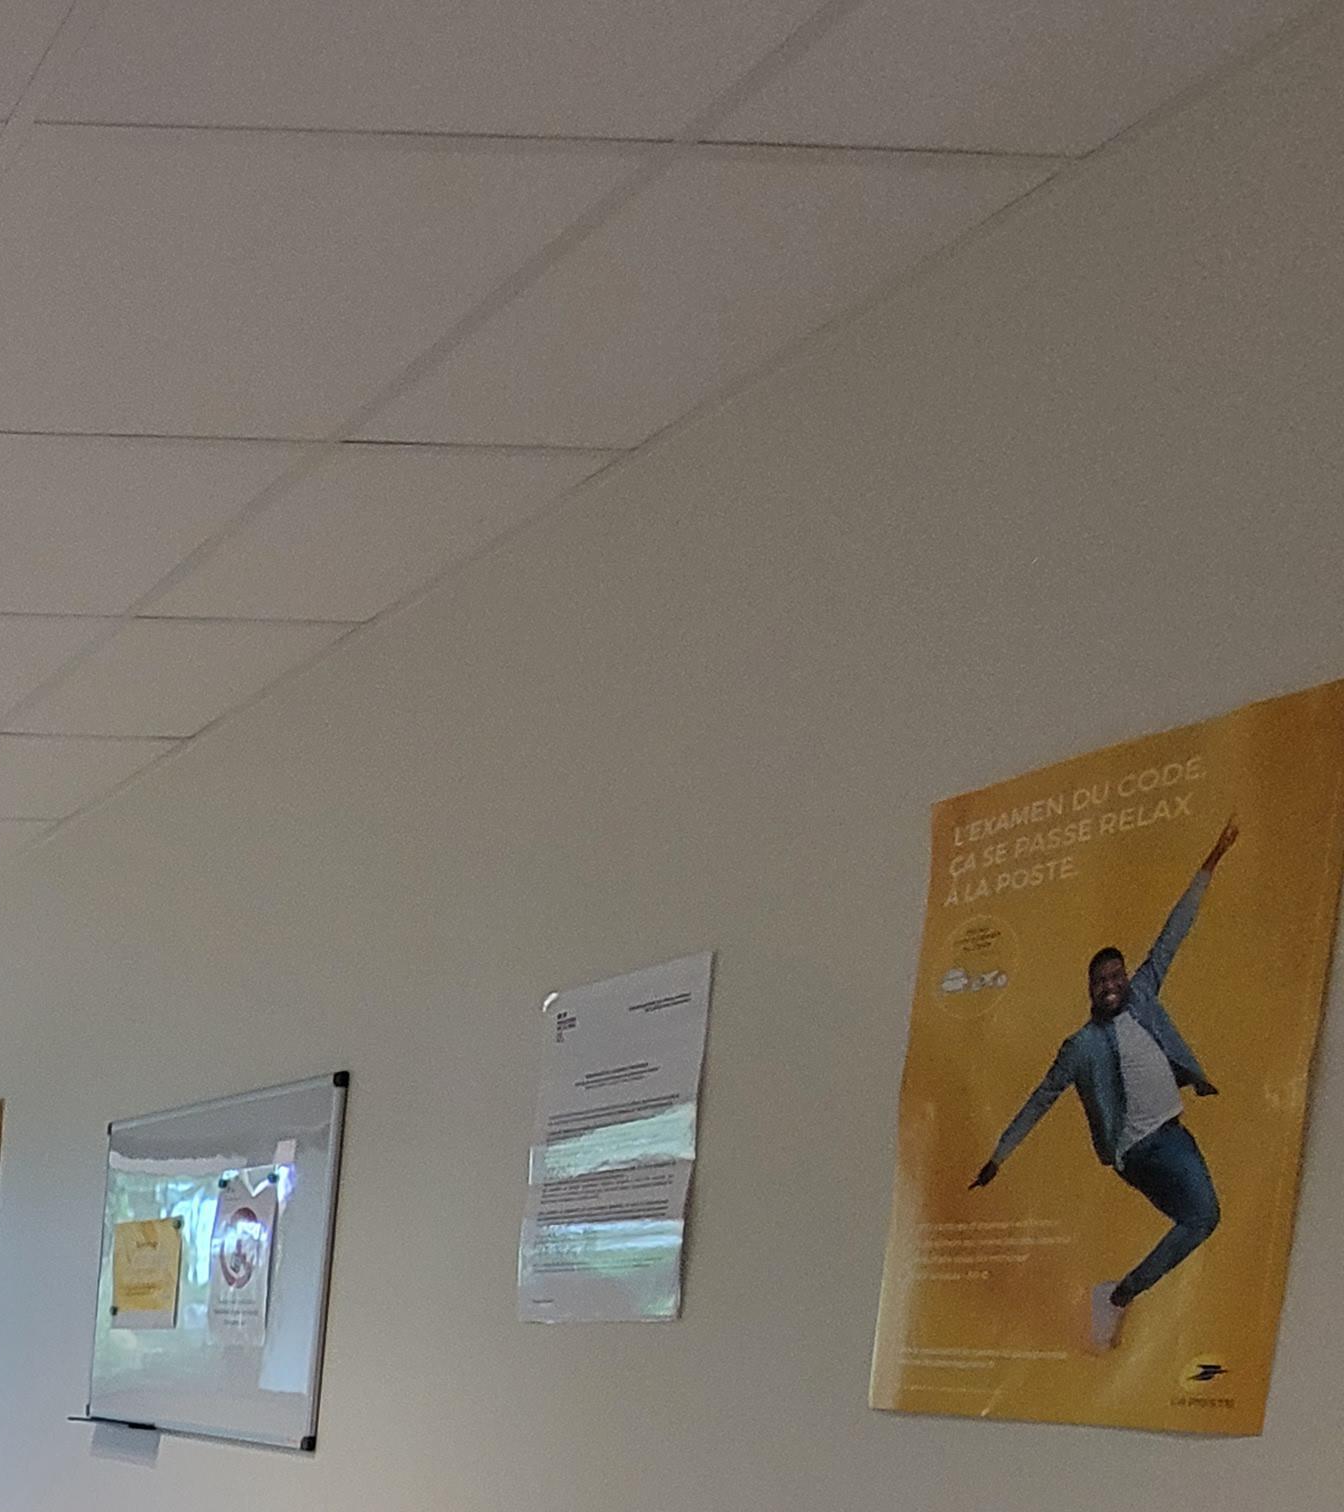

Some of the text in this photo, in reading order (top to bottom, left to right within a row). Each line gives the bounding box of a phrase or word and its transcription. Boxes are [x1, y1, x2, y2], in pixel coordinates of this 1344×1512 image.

[953, 795, 1064, 847] L'EXAMEN
[1072, 780, 1110, 812] DU
[983, 843, 1009, 868] SE
[1014, 818, 1093, 858] PASSE
[1099, 792, 1195, 835] RELAX
[964, 877, 990, 903] LA
